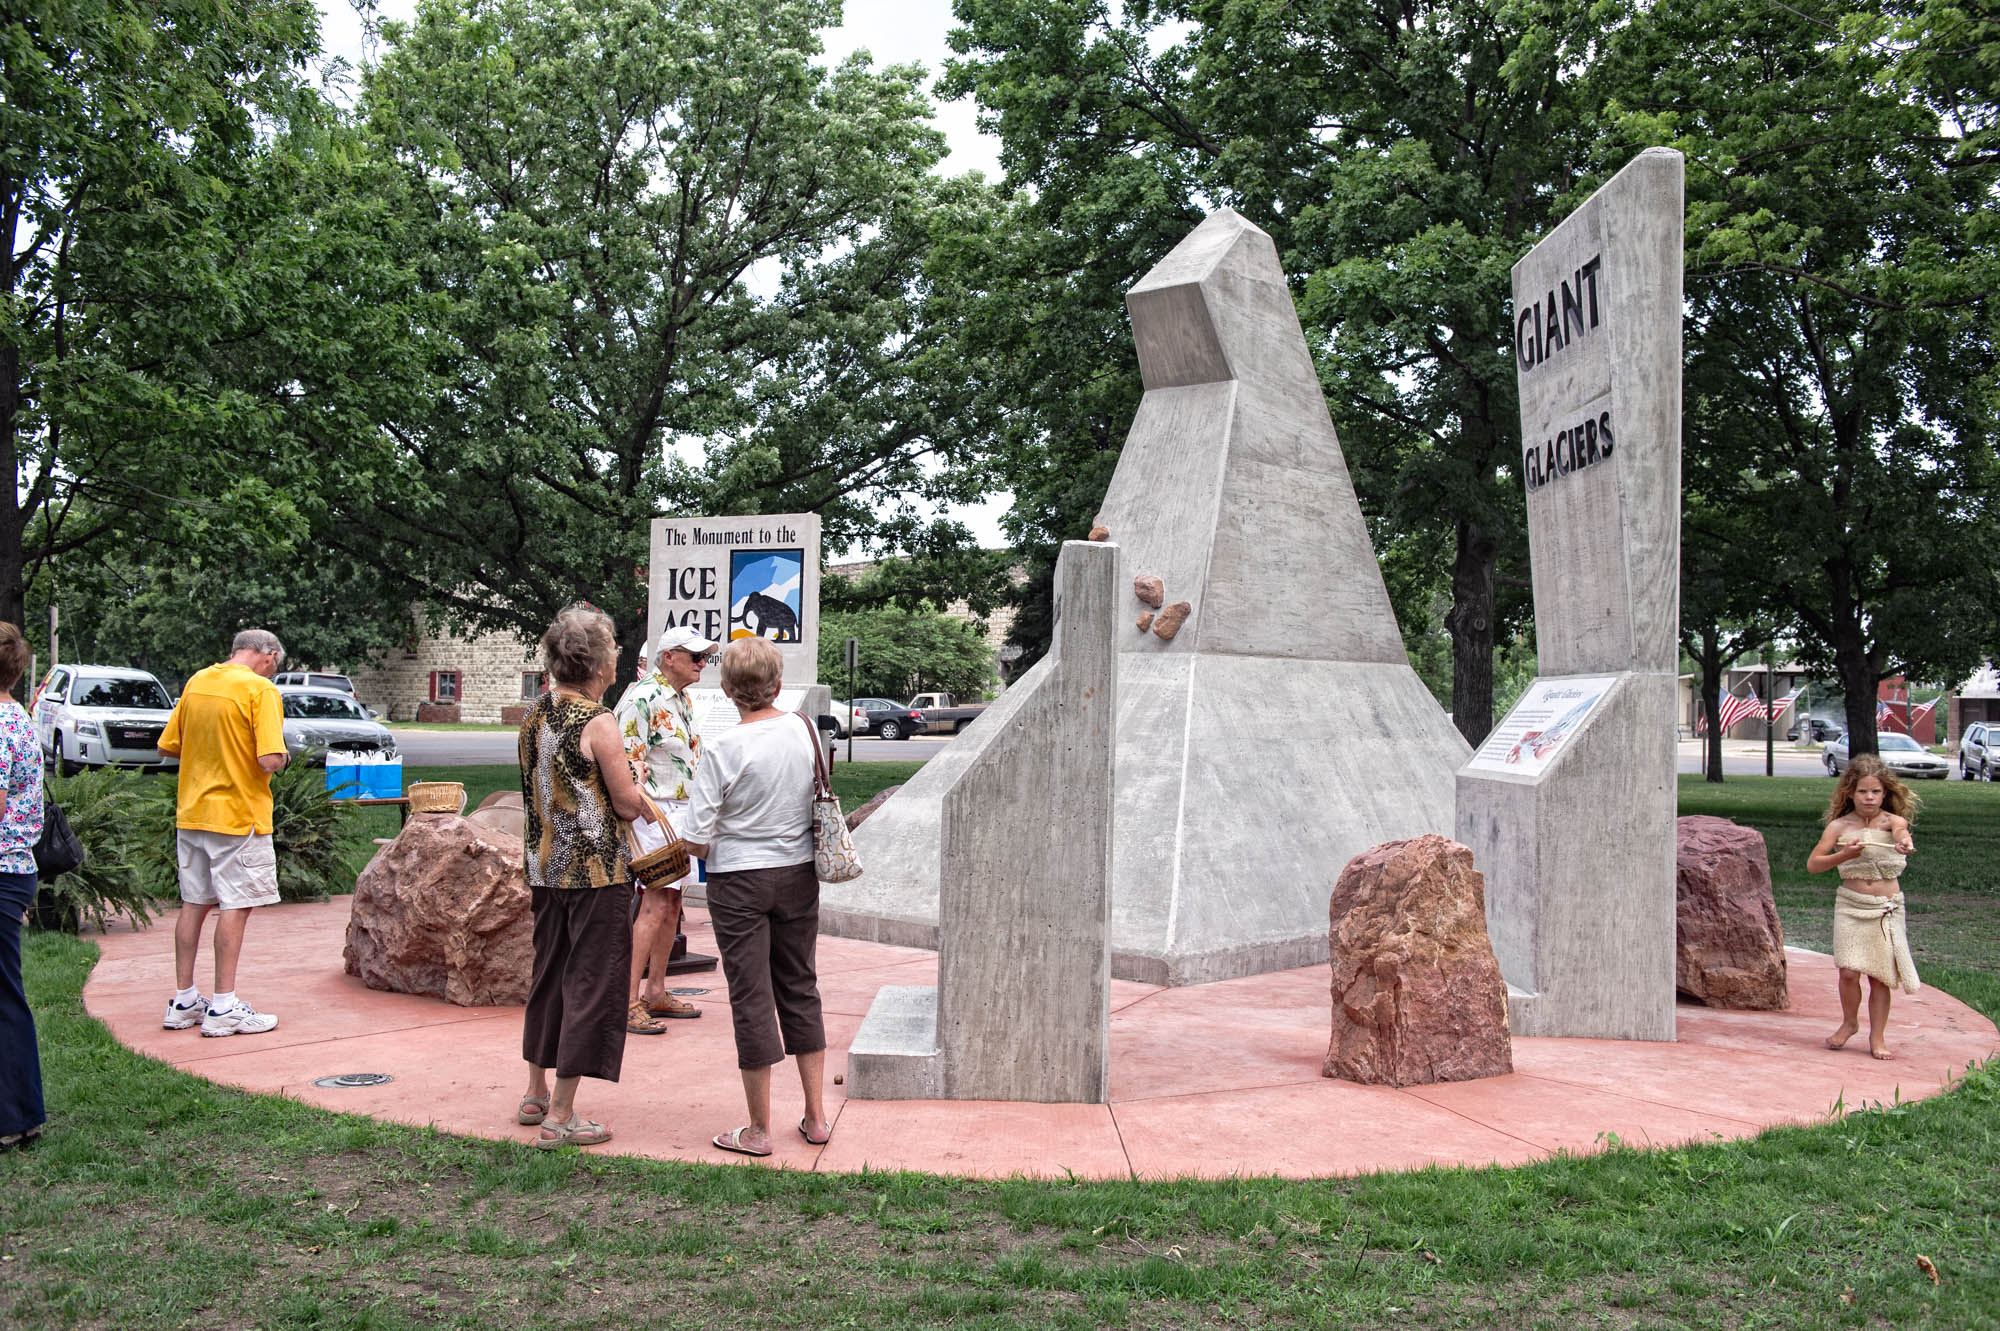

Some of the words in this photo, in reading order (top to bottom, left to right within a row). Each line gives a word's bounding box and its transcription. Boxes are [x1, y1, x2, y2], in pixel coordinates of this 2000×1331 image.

[1516, 253, 1601, 373] GIANT
[1525, 411, 1614, 494] GLACIERS
[665, 527, 688, 546] The
[692, 527, 754, 546] Monument
[759, 527, 772, 544] to
[776, 524, 797, 543] the
[668, 566, 717, 601] ICE
[664, 607, 722, 643] AGE
